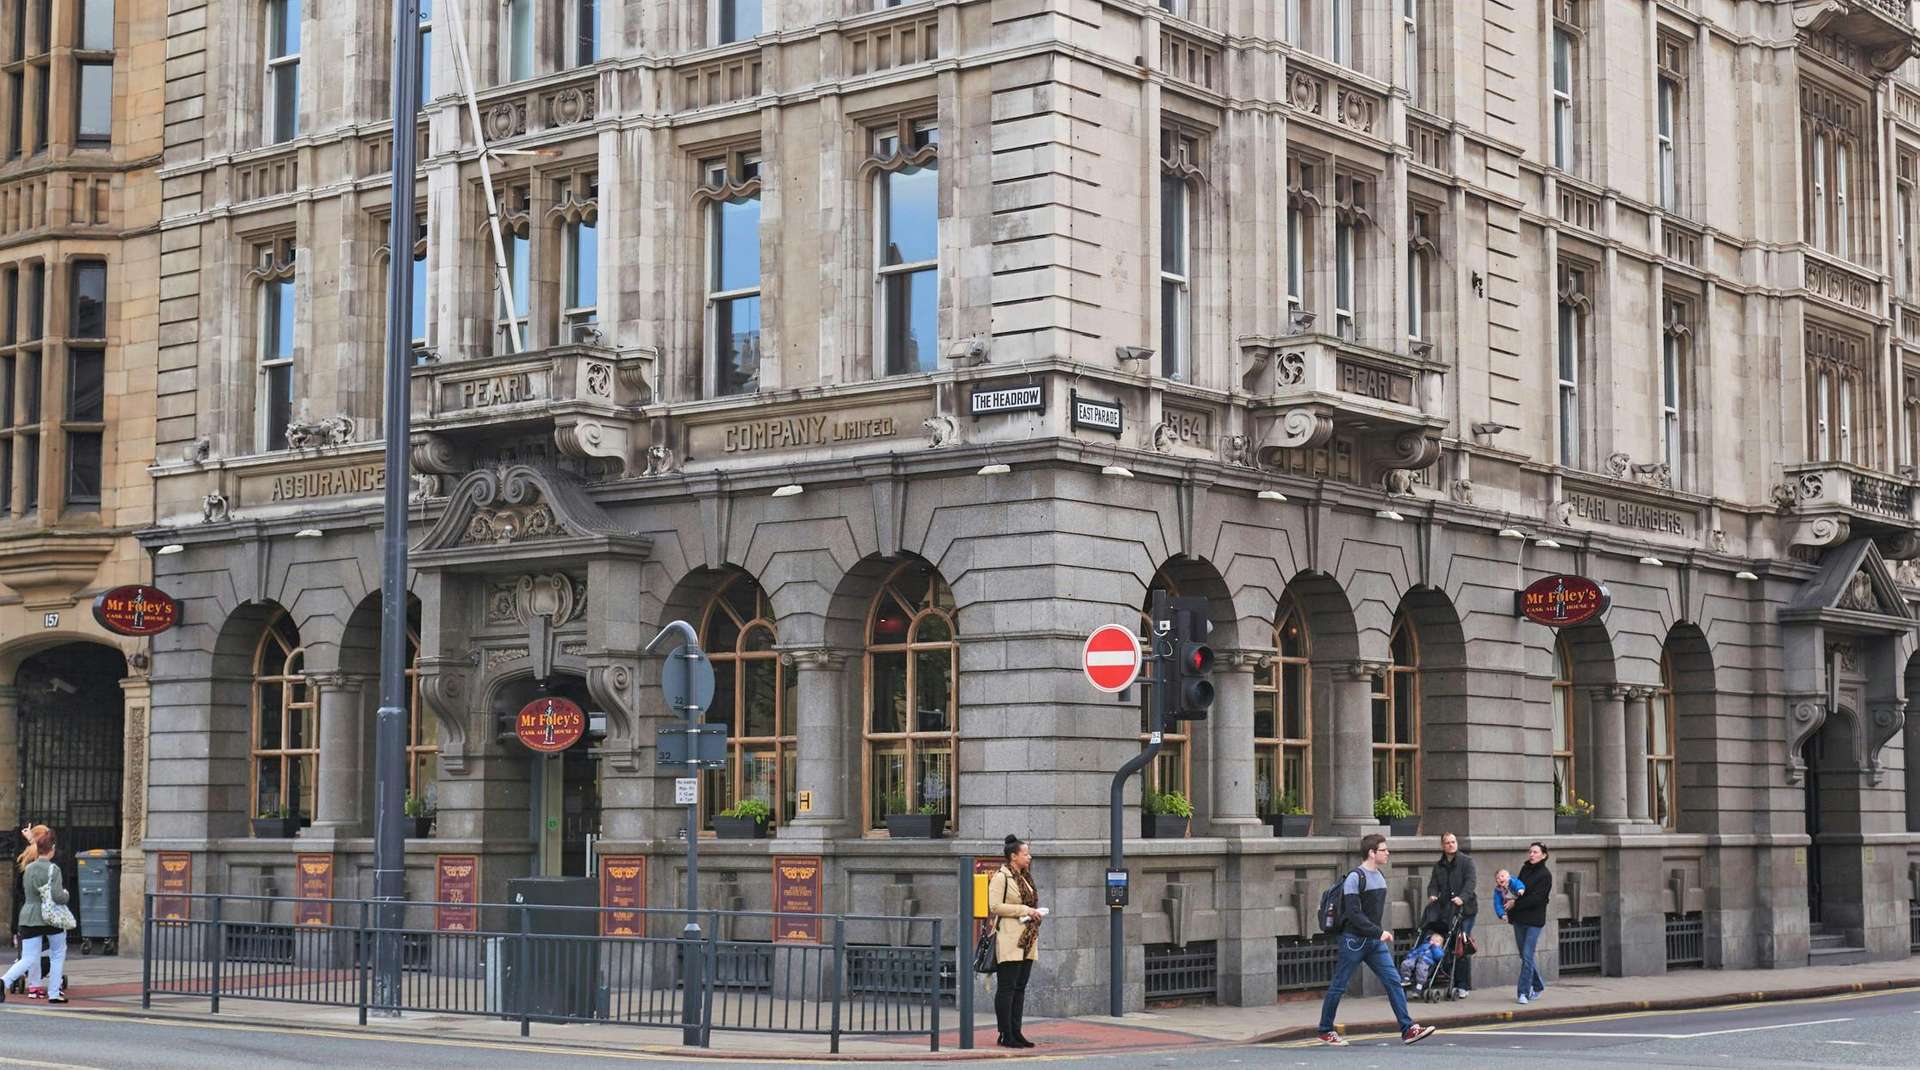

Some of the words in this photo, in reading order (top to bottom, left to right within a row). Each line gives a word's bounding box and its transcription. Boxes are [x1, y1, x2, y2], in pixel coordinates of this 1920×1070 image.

[462, 372, 536, 409] PEARL
[974, 394, 991, 409] THE
[993, 389, 1039, 408] HEADROW
[1078, 403, 1094, 421] EAST
[1094, 407, 1119, 425] PARADE
[724, 415, 827, 453] COMPANY,
[832, 416, 897, 442] LIMITED.
[272, 466, 386, 502] ASSURANCE
[1617, 503, 1685, 536] CHAMBERS.
[1527, 593, 1544, 605] Mr
[1548, 588, 1596, 604] Foley's
[107, 599, 124, 611] Mr
[128, 599, 172, 616] Foley's
[45, 614, 59, 627] 157
[521, 714, 537, 727] Mr
[539, 713, 580, 728] Foley's
[800, 792, 809, 810] H
